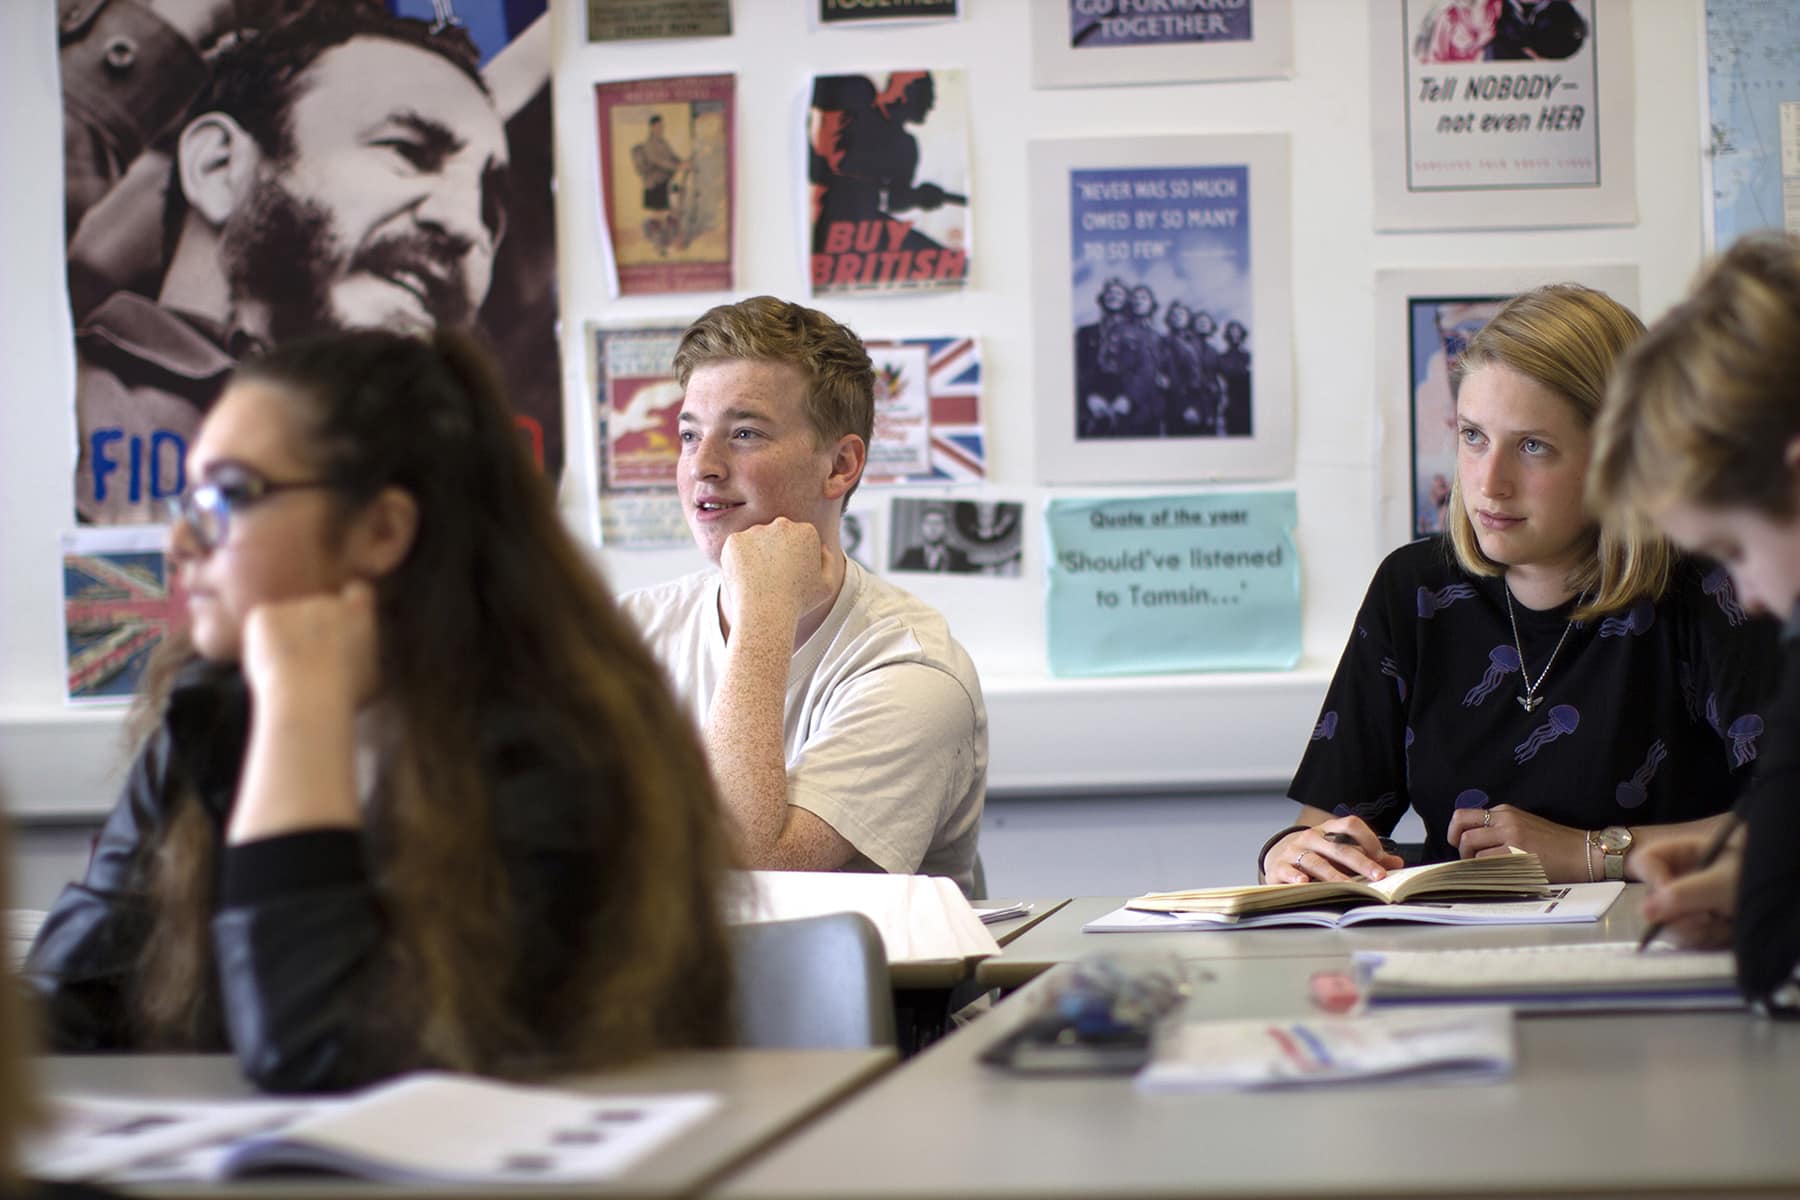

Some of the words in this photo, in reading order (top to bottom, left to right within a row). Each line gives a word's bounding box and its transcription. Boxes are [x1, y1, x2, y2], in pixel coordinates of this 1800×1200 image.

[1101, 13, 1231, 37] TOGETHER
[1419, 76, 1458, 103] Tell
[1436, 111, 1476, 133] not
[1479, 113, 1532, 134] even
[1536, 104, 1586, 133] HER
[1134, 180, 1168, 200] WAS
[1169, 178, 1191, 199] SO
[1192, 177, 1238, 198] MUCH
[1082, 210, 1130, 231] OWED
[1134, 208, 1157, 230] BY
[1160, 208, 1185, 229] SO
[1187, 207, 1240, 228] MANY
[826, 221, 914, 252] BUY
[1084, 240, 1104, 261] TO
[1106, 240, 1130, 259] SO
[811, 247, 966, 286] BRITISH
[91, 428, 186, 504] FID
[1090, 508, 1145, 529] Quote
[1151, 507, 1171, 527] of
[1174, 507, 1204, 526] the
[1209, 510, 1249, 527] year
[1189, 545, 1284, 570] listened
[1095, 589, 1121, 608] to
